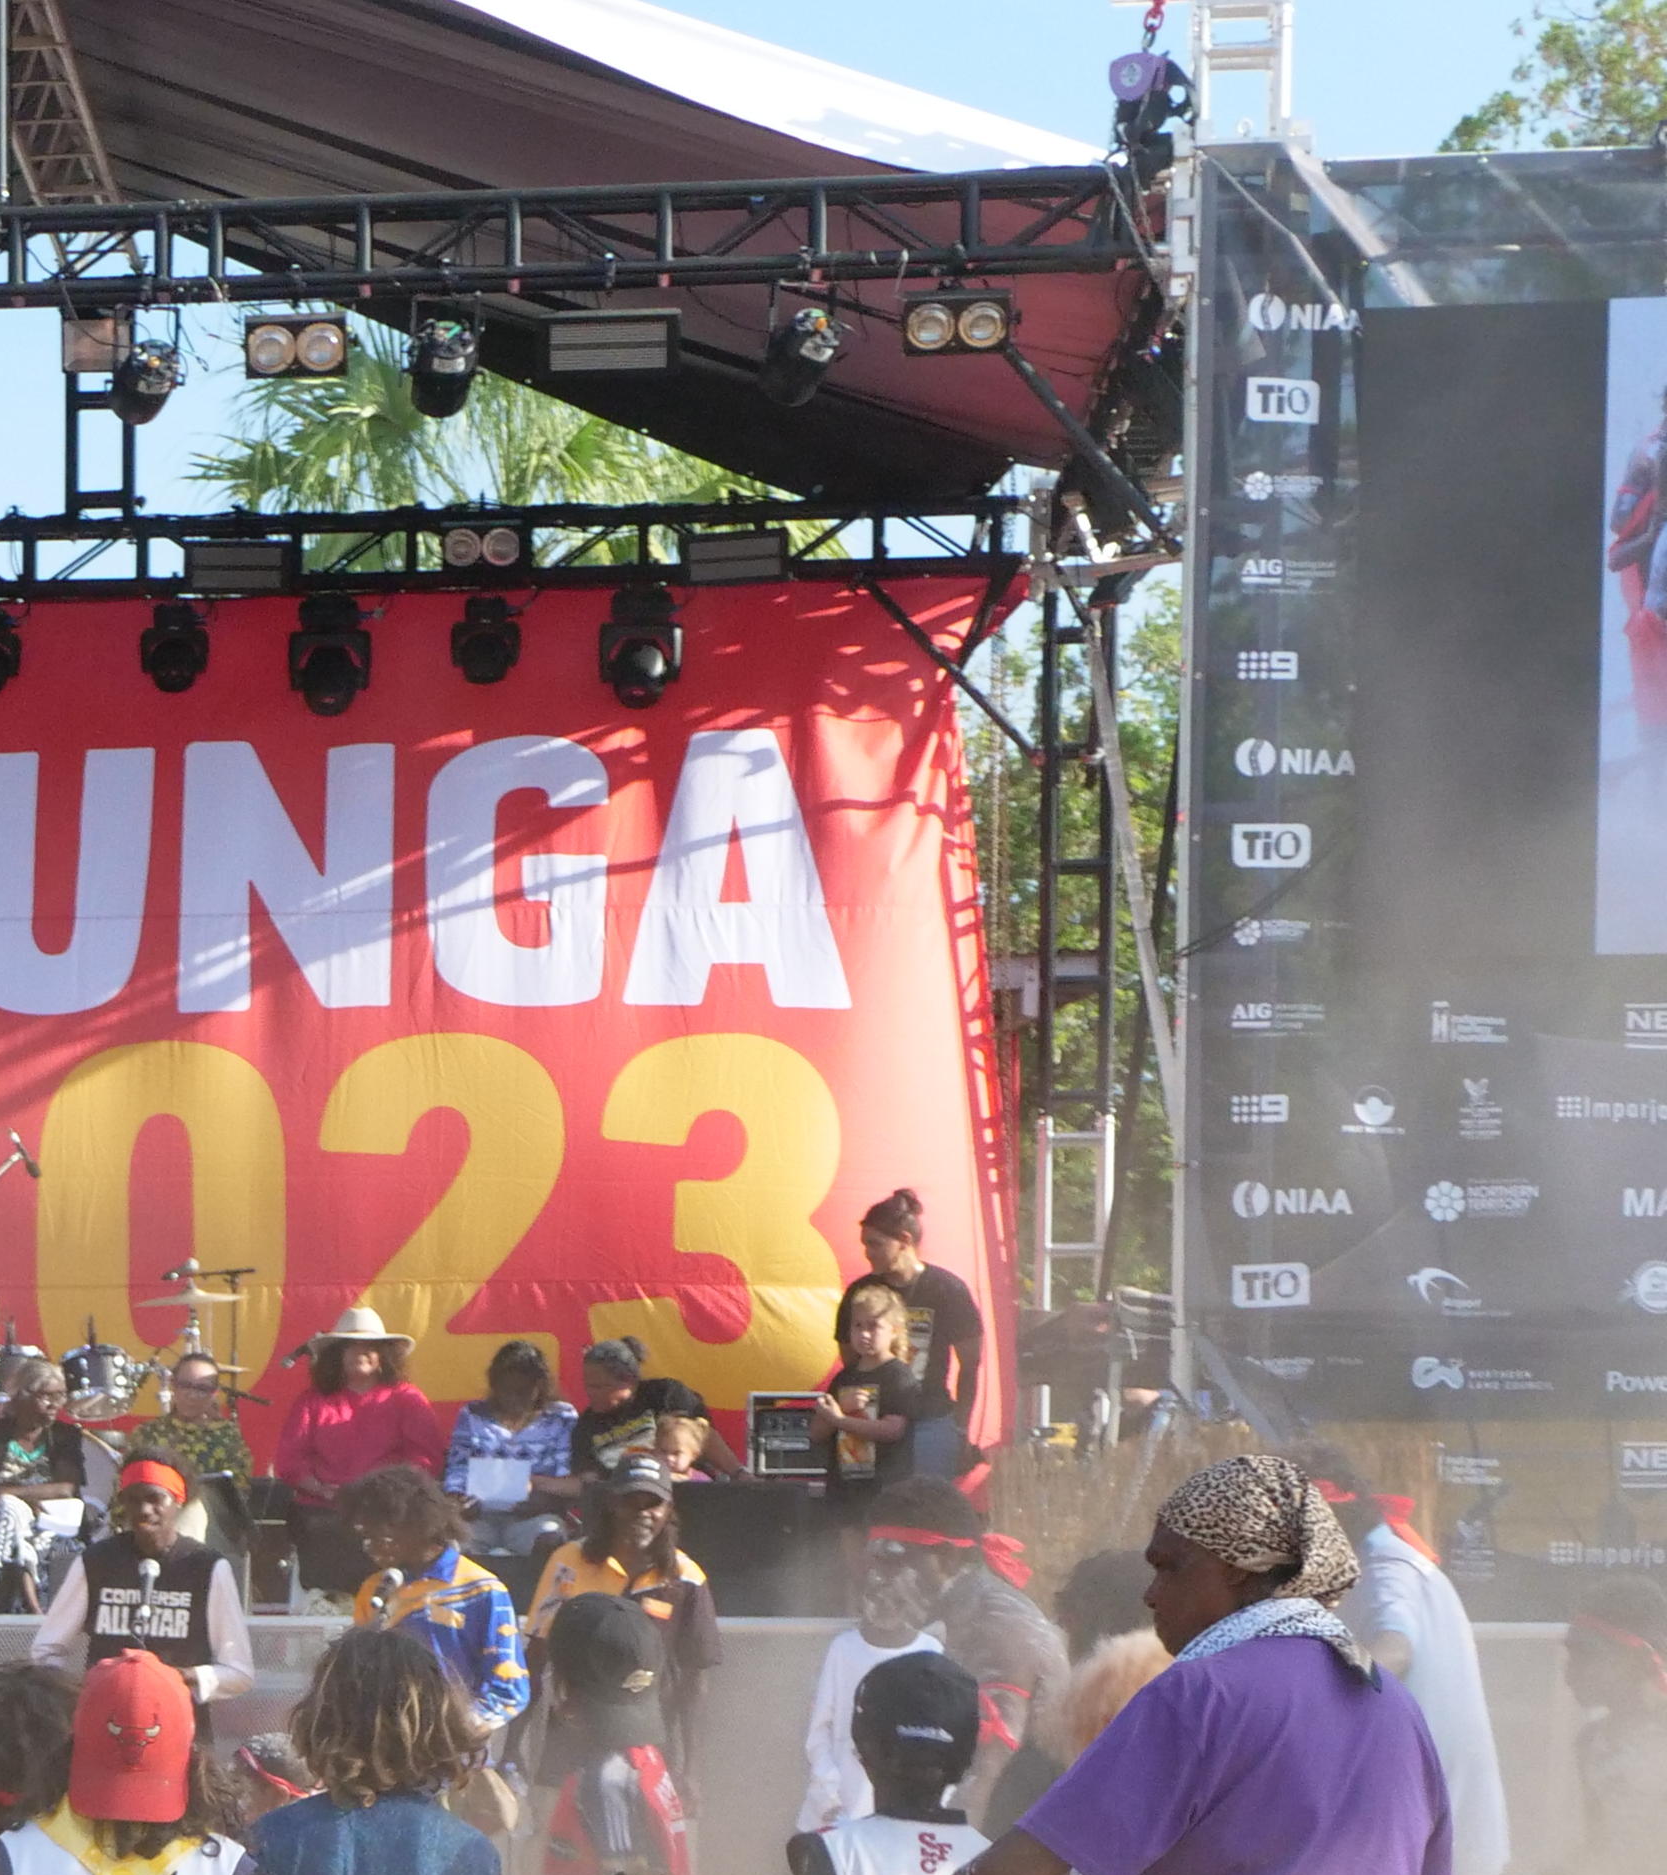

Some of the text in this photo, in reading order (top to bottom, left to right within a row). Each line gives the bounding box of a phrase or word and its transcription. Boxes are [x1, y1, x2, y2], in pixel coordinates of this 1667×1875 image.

[1241, 558, 1283, 575] AIG
[1281, 748, 1355, 776] NIAA
[1231, 1003, 1272, 1019] AIG
[1274, 1188, 1354, 1215] NIAA
[99, 1587, 192, 1608] CONERSE
[95, 1604, 131, 1636] ALL
